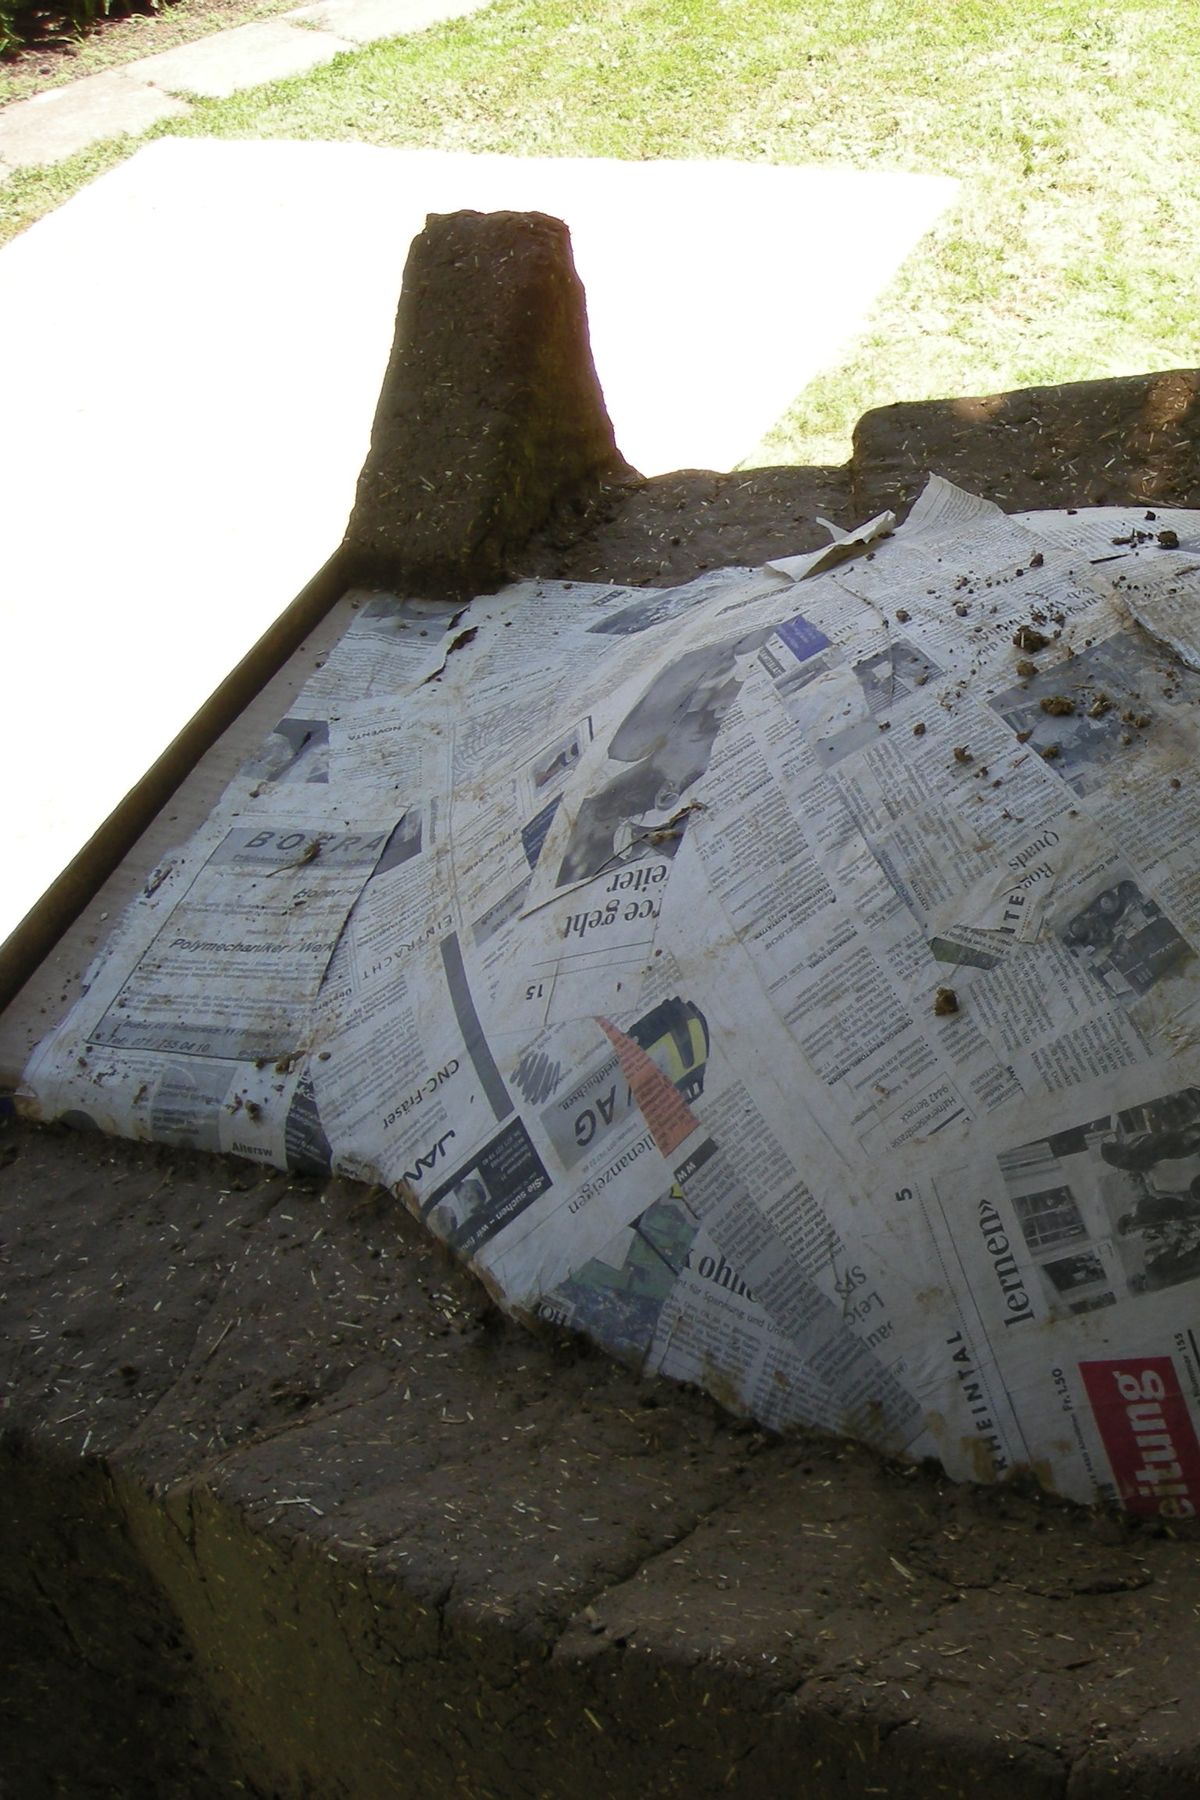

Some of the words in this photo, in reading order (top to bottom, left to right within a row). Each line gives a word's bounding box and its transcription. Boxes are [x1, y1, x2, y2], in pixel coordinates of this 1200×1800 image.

[1006, 825, 1060, 874] Quads
[600, 860, 673, 897] eiter
[551, 899, 623, 944] geht
[169, 936, 288, 954] Polymechaniker
[361, 914, 453, 982] EINTRACHT
[520, 982, 547, 1002] 15
[377, 1056, 463, 1133] CNC-Fräser
[898, 1097, 929, 1124] Berneck
[926, 1084, 949, 1105] 9442
[565, 1083, 631, 1149] AG
[494, 1189, 528, 1221] suchen
[893, 1185, 914, 1203] 5
[474, 1222, 489, 1239] wir
[967, 1196, 1036, 1327] lernen»
[1172, 1332, 1187, 1352] 155
